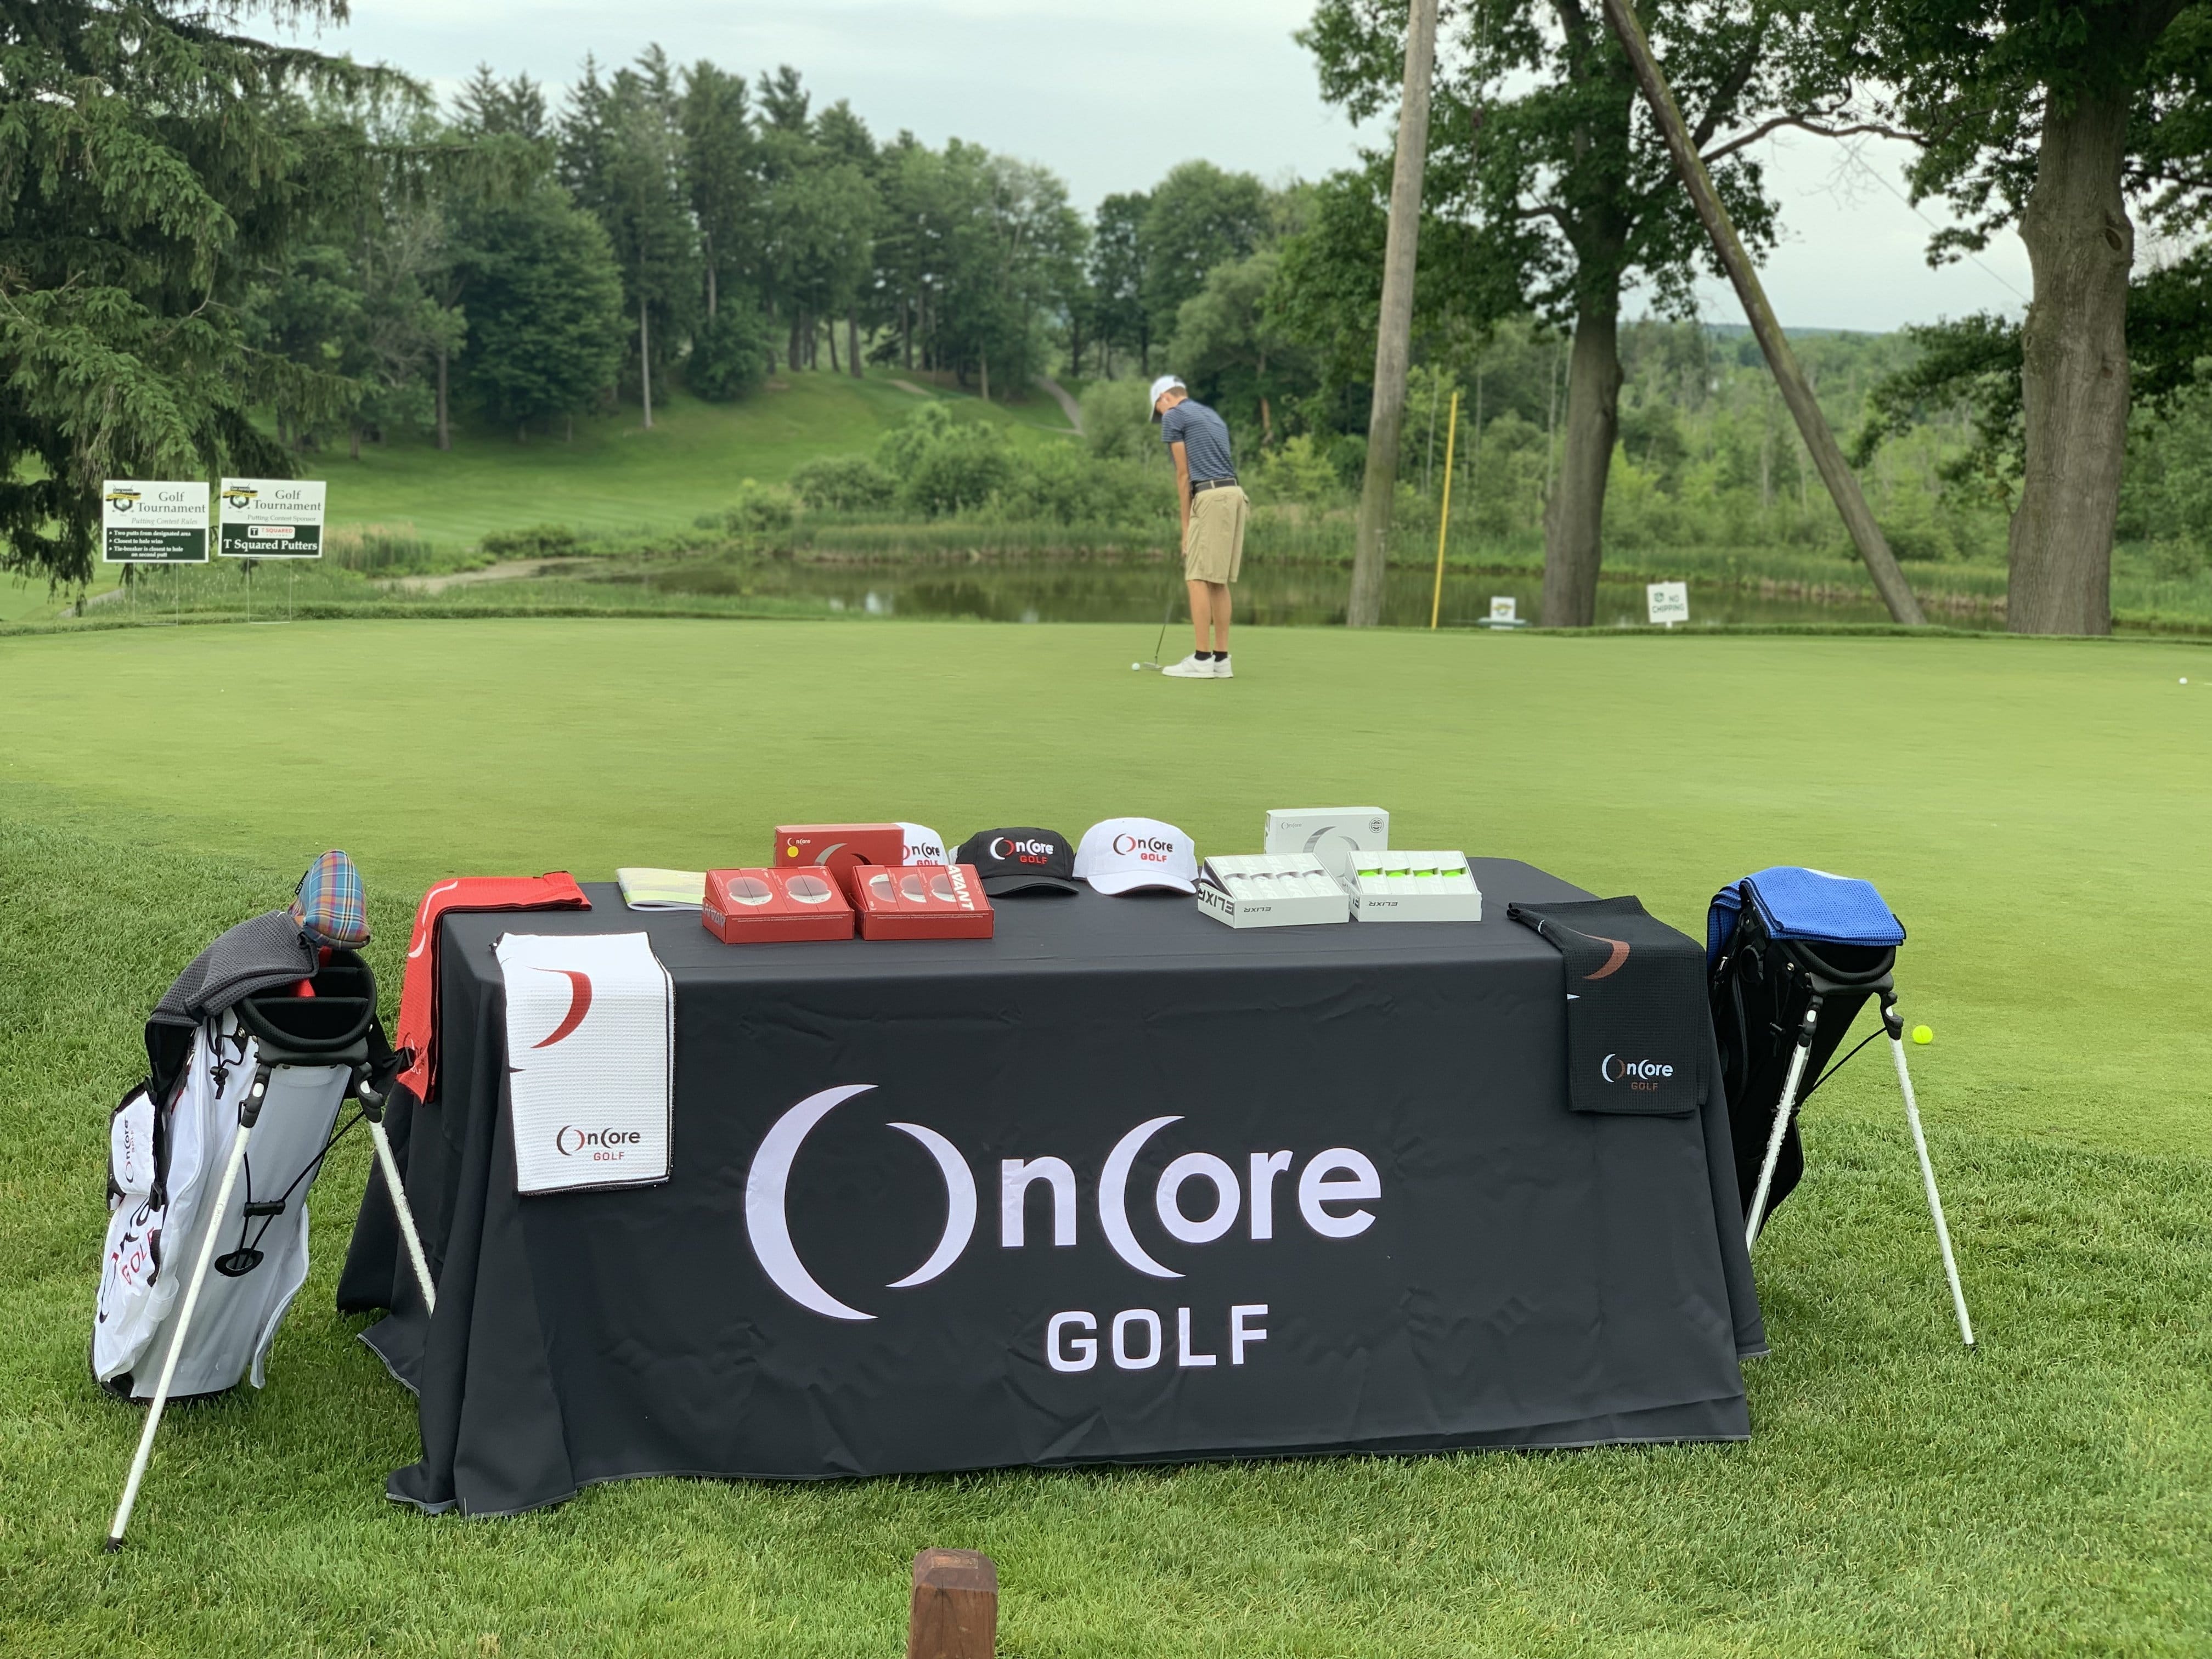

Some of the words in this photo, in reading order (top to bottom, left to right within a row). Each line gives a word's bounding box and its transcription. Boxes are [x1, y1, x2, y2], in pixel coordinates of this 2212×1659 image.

[159, 492, 185, 501] Golf
[275, 490, 301, 500] Golf
[137, 503, 206, 513] Tournament
[253, 500, 321, 511] Tournament
[223, 539, 232, 549] T
[234, 539, 279, 552] Squared
[281, 540, 318, 550] Putters
[1652, 603, 1685, 613] CHIPPING
[989, 836, 1054, 860] OnCore
[1113, 833, 1173, 855] OnCore
[1019, 855, 1047, 864] GOLF
[1140, 853, 1167, 862] GOLF
[947, 865, 975, 911] AVANT
[1198, 888, 1234, 916] ELIXR
[1601, 1053, 1673, 1082] OnCore
[1631, 1082, 1658, 1091] GOLF
[556, 1125, 641, 1156] OnCore
[593, 1151, 625, 1161] GOLF
[745, 1084, 1382, 1320] OnCore
[1047, 1304, 1268, 1372] GOLF
